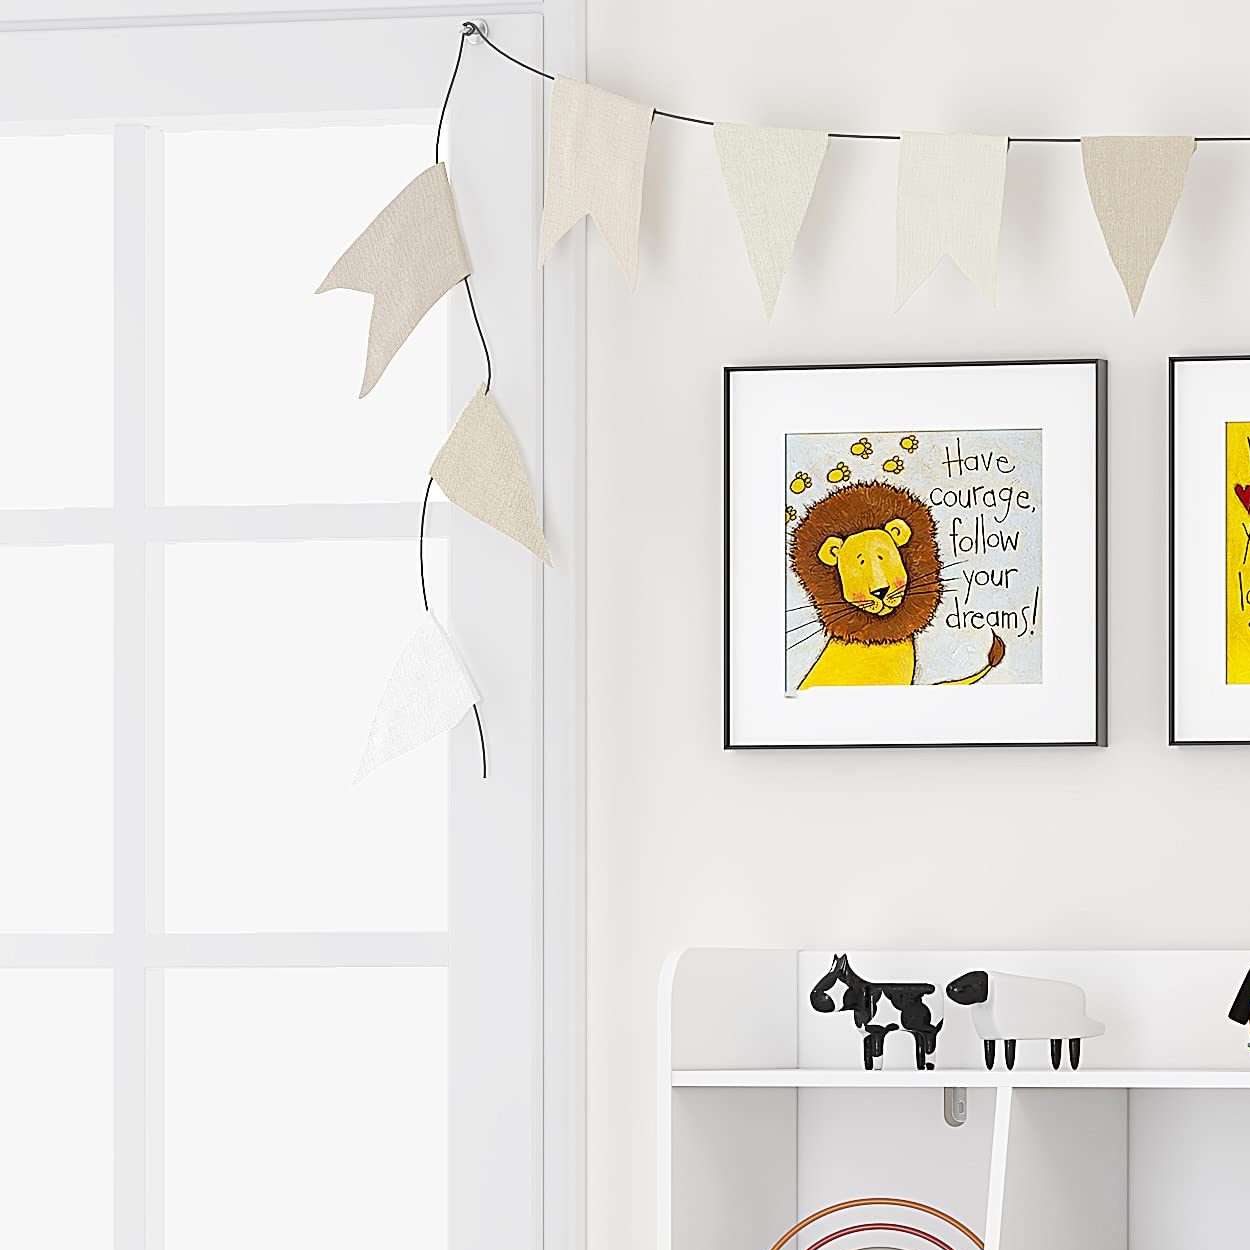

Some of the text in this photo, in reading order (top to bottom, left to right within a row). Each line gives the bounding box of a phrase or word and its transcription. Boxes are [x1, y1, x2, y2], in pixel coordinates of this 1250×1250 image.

[942, 437, 1016, 478] Have
[930, 486, 1036, 523] courage,
[950, 514, 1019, 557] follow
[962, 568, 1019, 605] your
[945, 586, 1039, 638] dreams!
